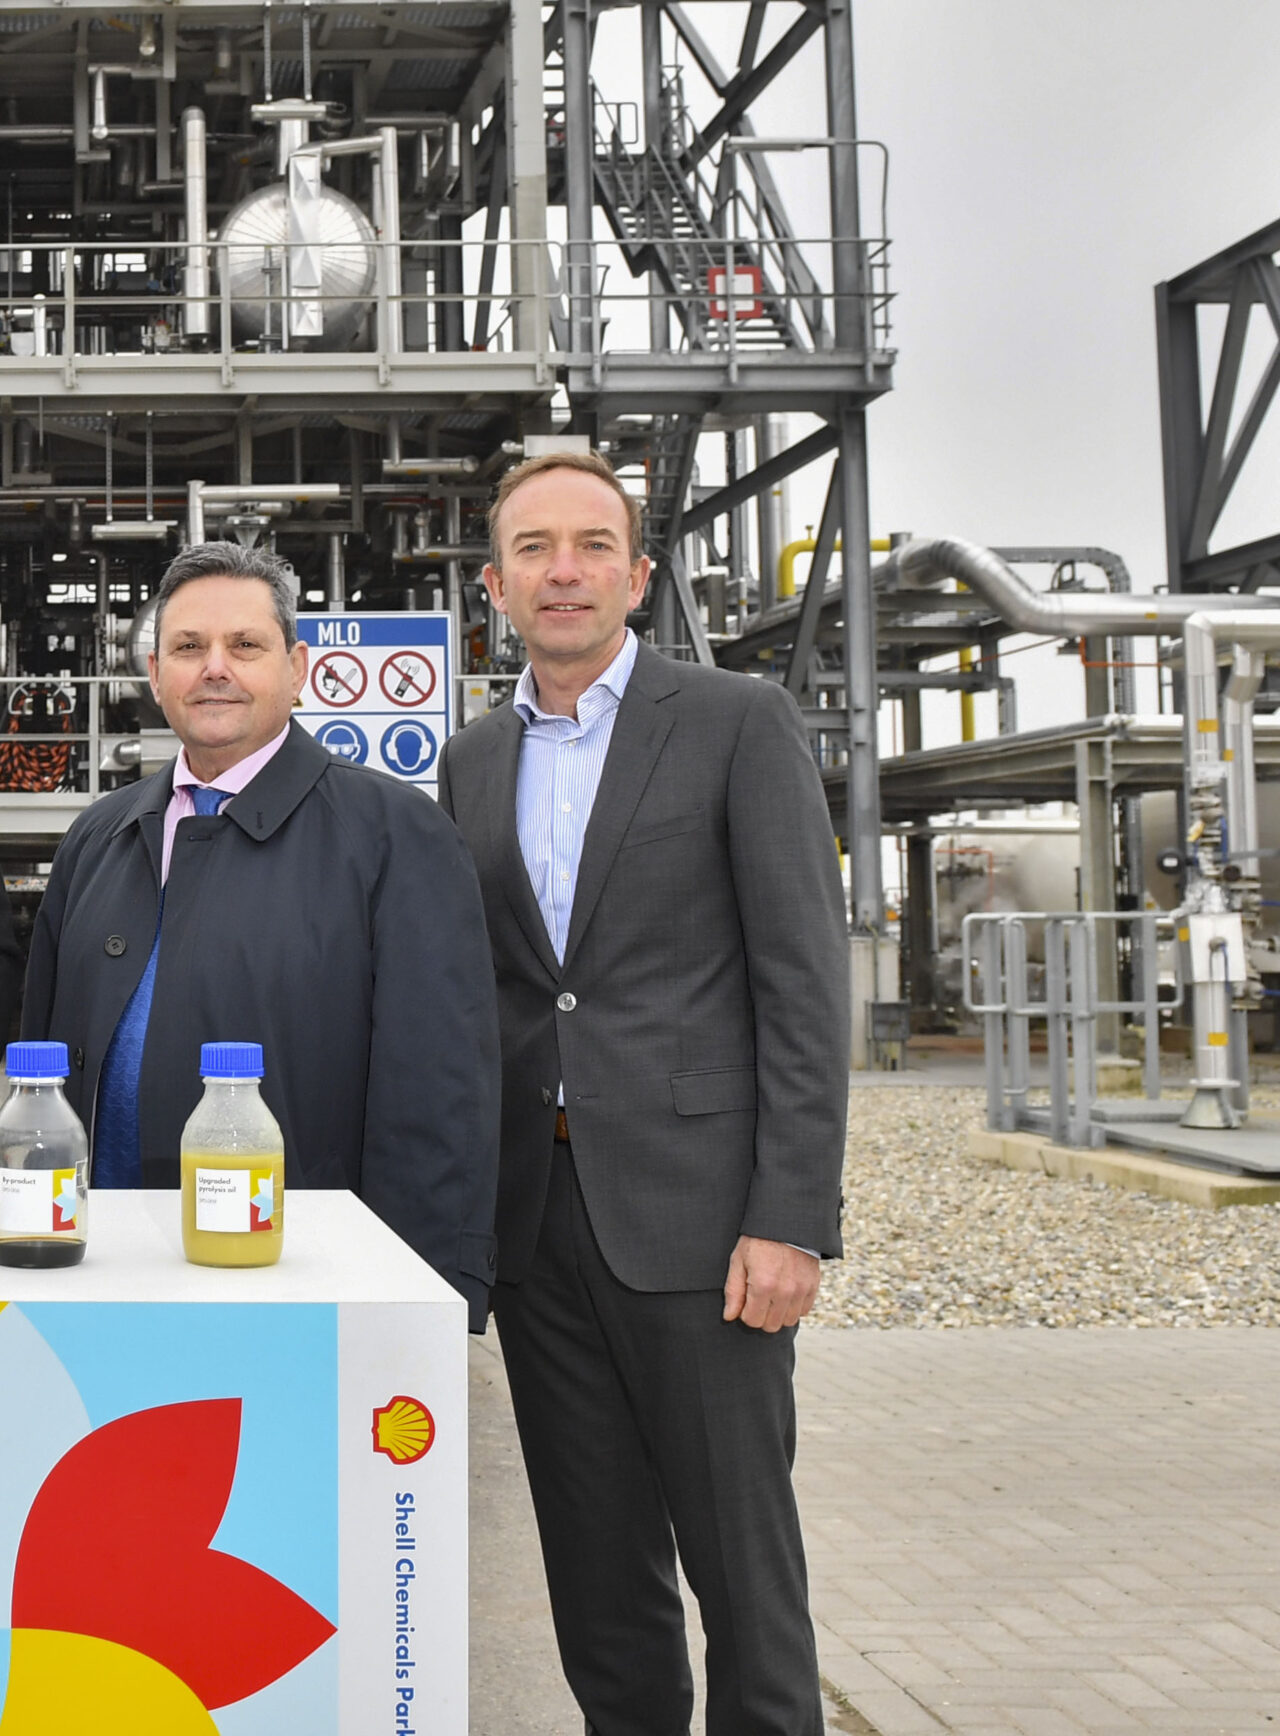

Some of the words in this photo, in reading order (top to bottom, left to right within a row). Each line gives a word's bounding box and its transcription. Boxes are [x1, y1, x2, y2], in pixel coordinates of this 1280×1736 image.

[318, 621, 360, 645] MLO
[2, 1176, 36, 1185] By-product
[198, 1177, 231, 1185] Upgraded
[198, 1186, 226, 1194] pyrolysis
[396, 1492, 416, 1551] Shell
[396, 1558, 416, 1680] Chemicals
